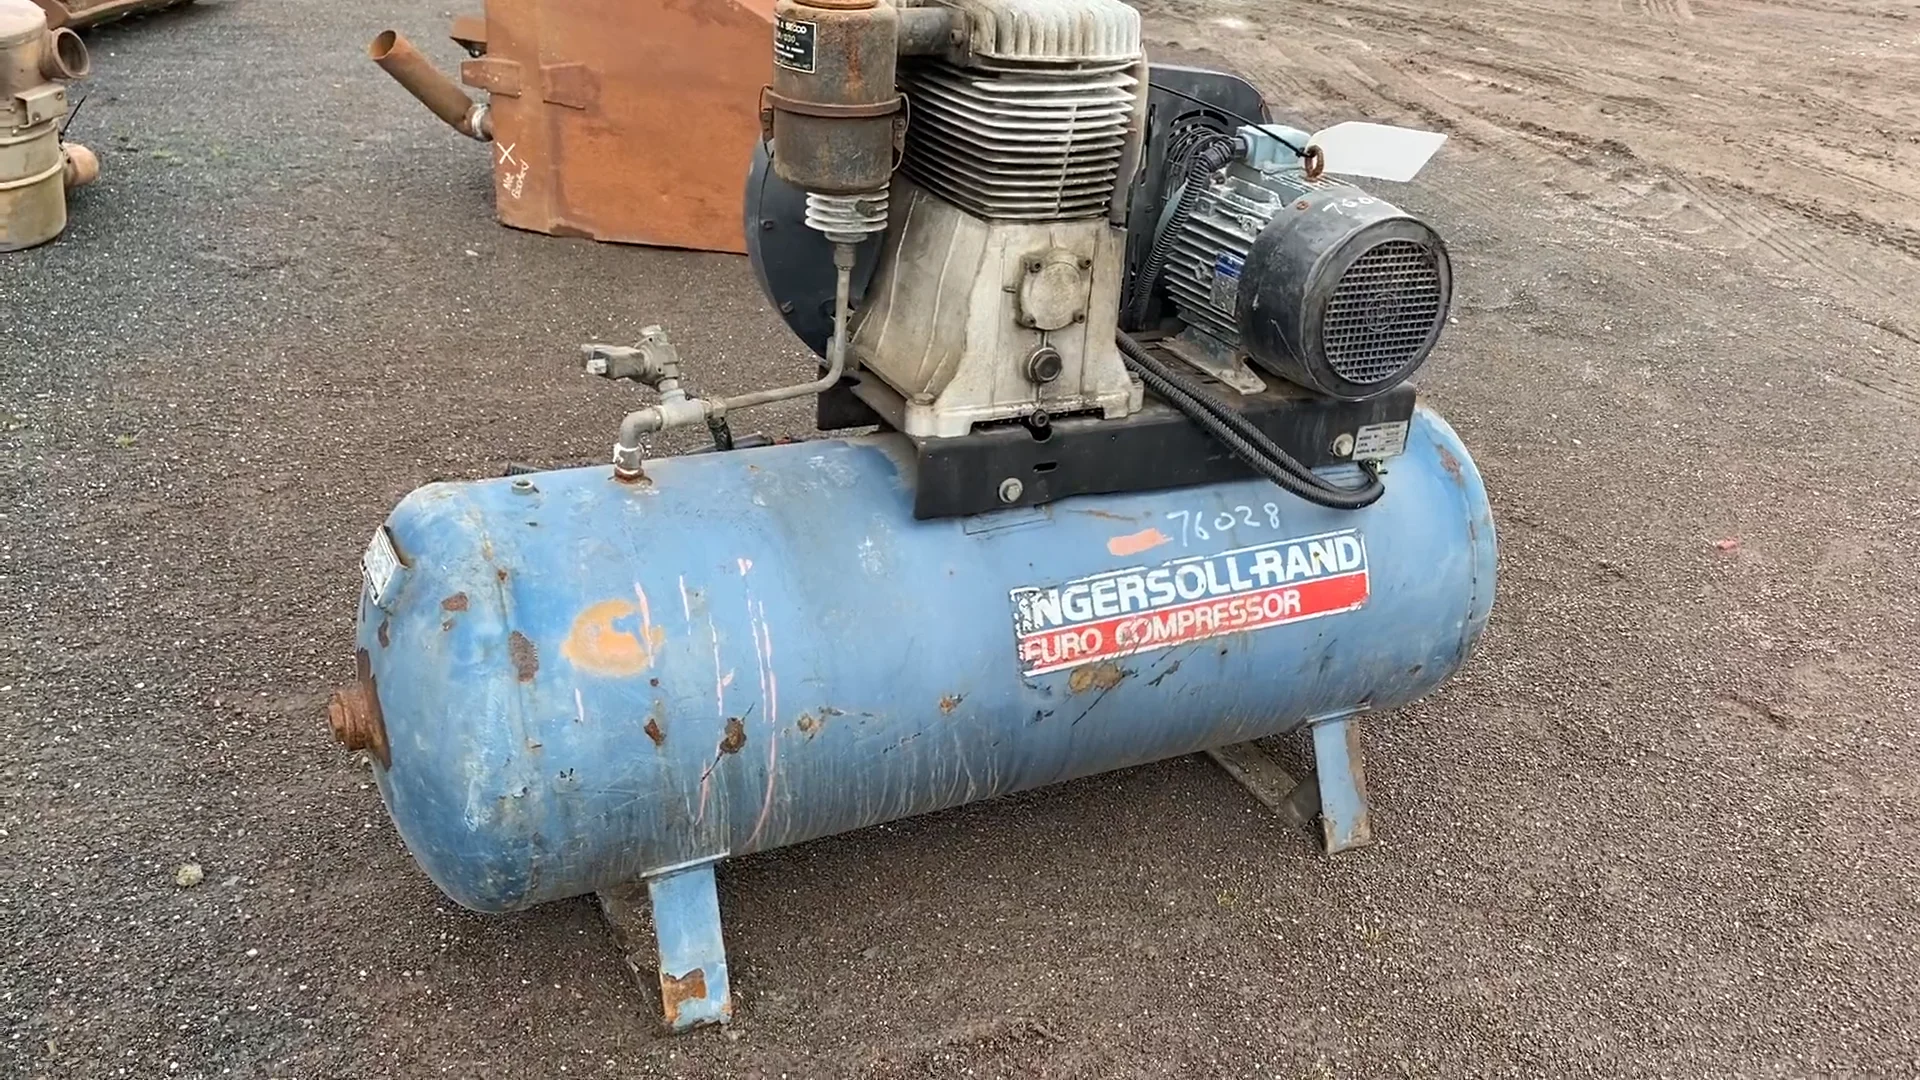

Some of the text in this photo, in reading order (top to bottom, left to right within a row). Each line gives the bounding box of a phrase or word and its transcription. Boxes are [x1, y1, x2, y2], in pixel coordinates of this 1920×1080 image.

[1167, 502, 1280, 547] 76028
[1022, 589, 1301, 665] EURO COMPRESSOR
